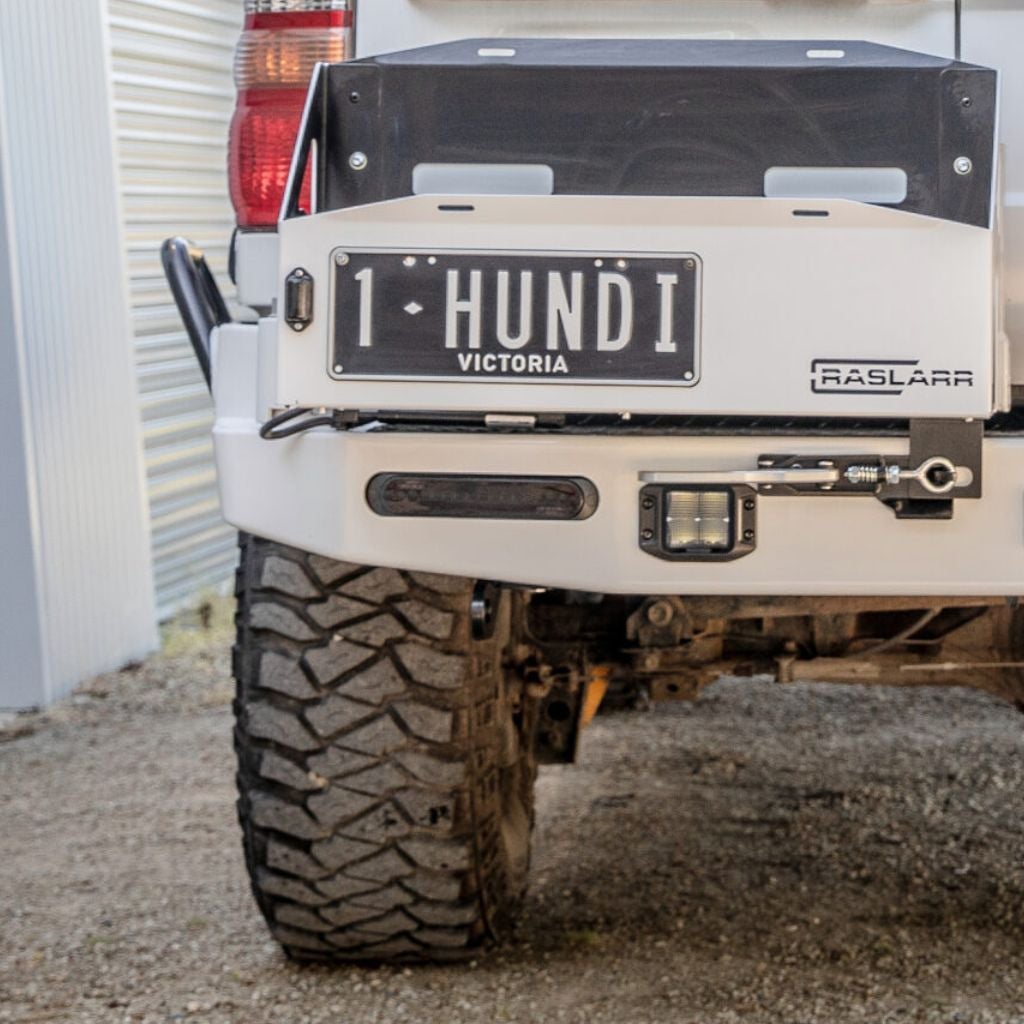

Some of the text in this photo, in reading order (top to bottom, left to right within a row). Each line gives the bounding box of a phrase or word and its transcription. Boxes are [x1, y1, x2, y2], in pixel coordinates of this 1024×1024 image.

[354, 268, 679, 353] 1 HUNDI
[457, 353, 569, 374] VICTORIA
[811, 359, 975, 394] RASLARR
